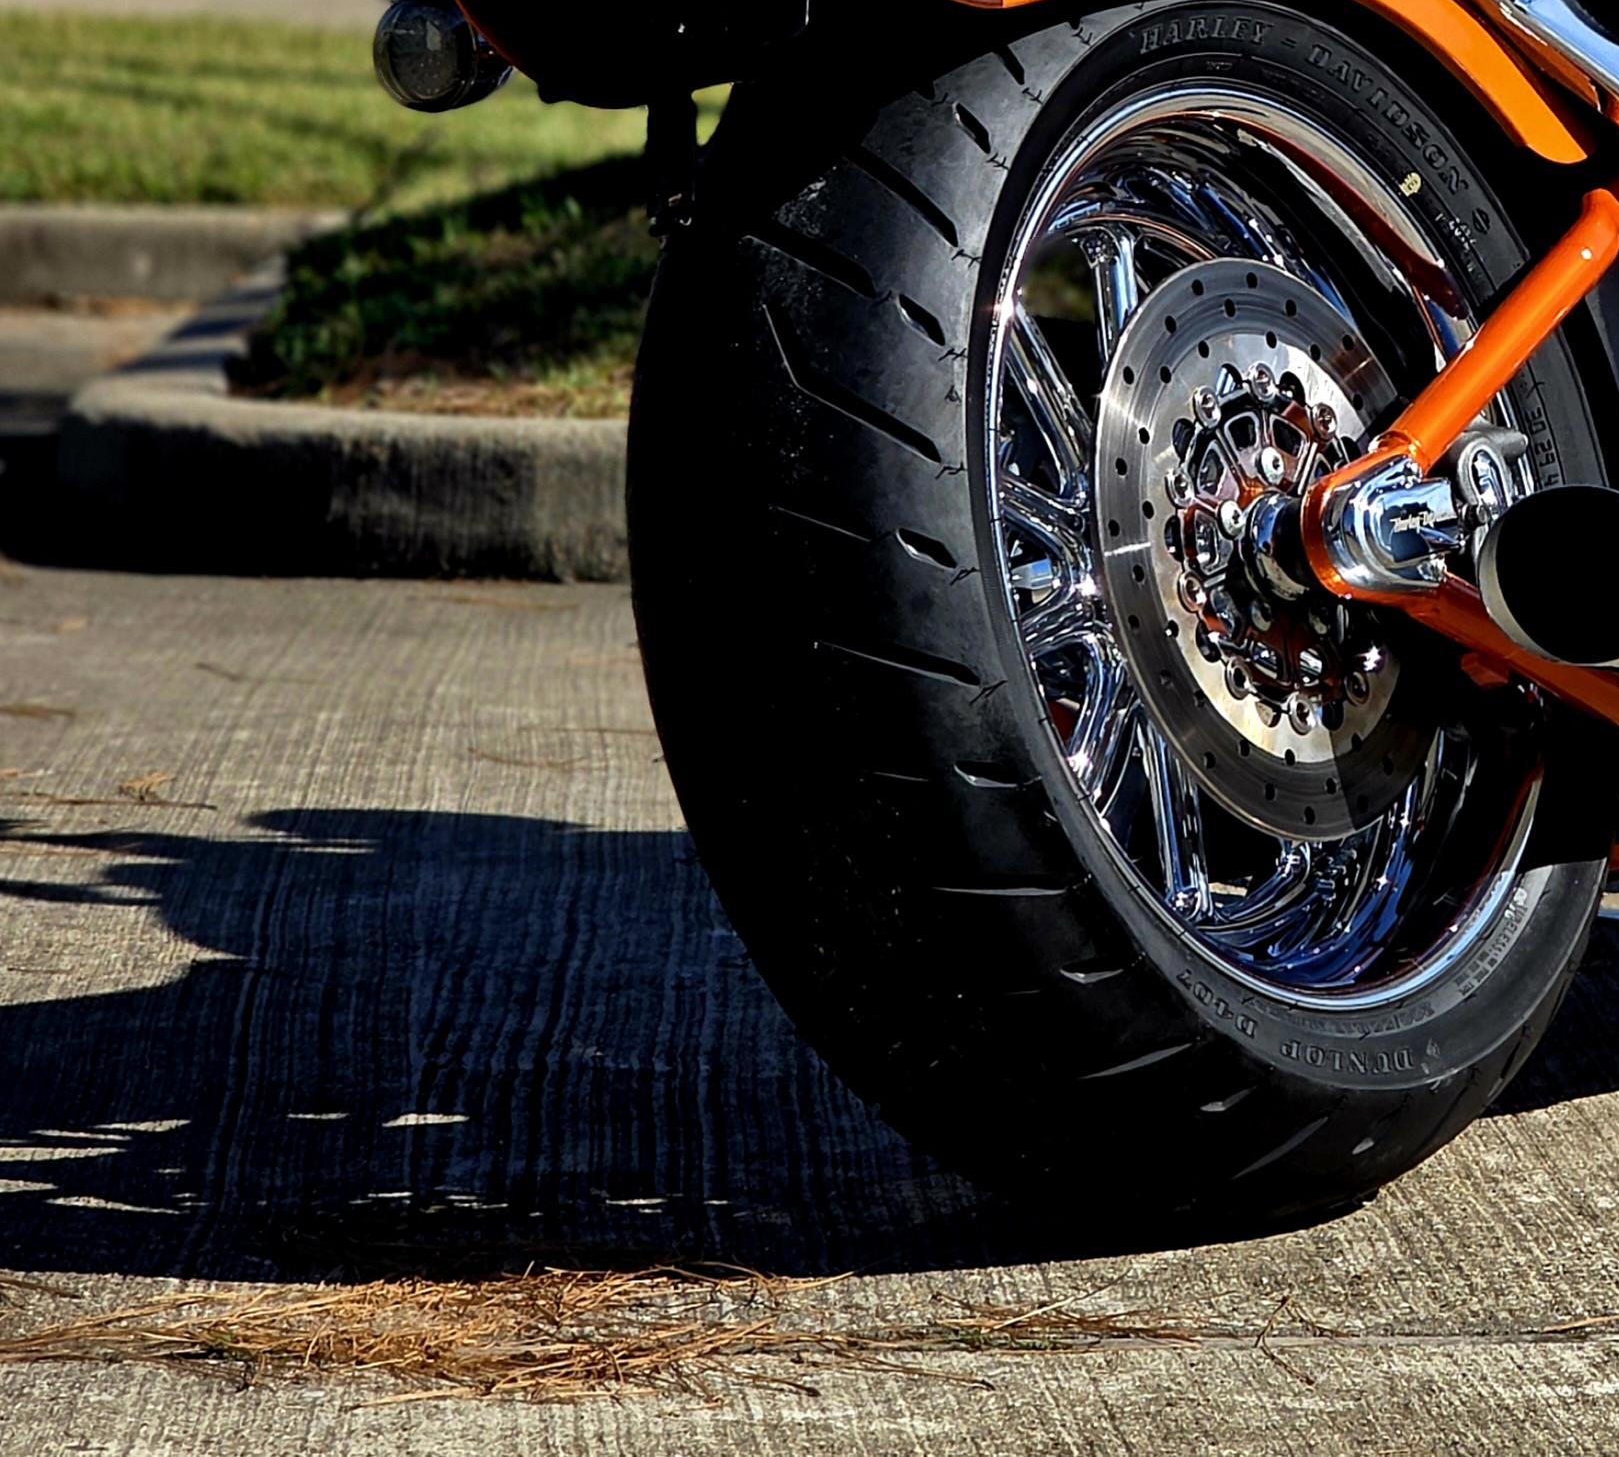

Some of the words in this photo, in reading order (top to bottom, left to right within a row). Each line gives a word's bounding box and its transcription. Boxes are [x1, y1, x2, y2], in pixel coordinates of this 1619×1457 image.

[1140, 15, 1275, 55] HARLEY
[1305, 43, 1470, 195] DAVIDSON
[1176, 969, 1259, 1039] D407
[1280, 1039, 1415, 1075] DUNLOP
